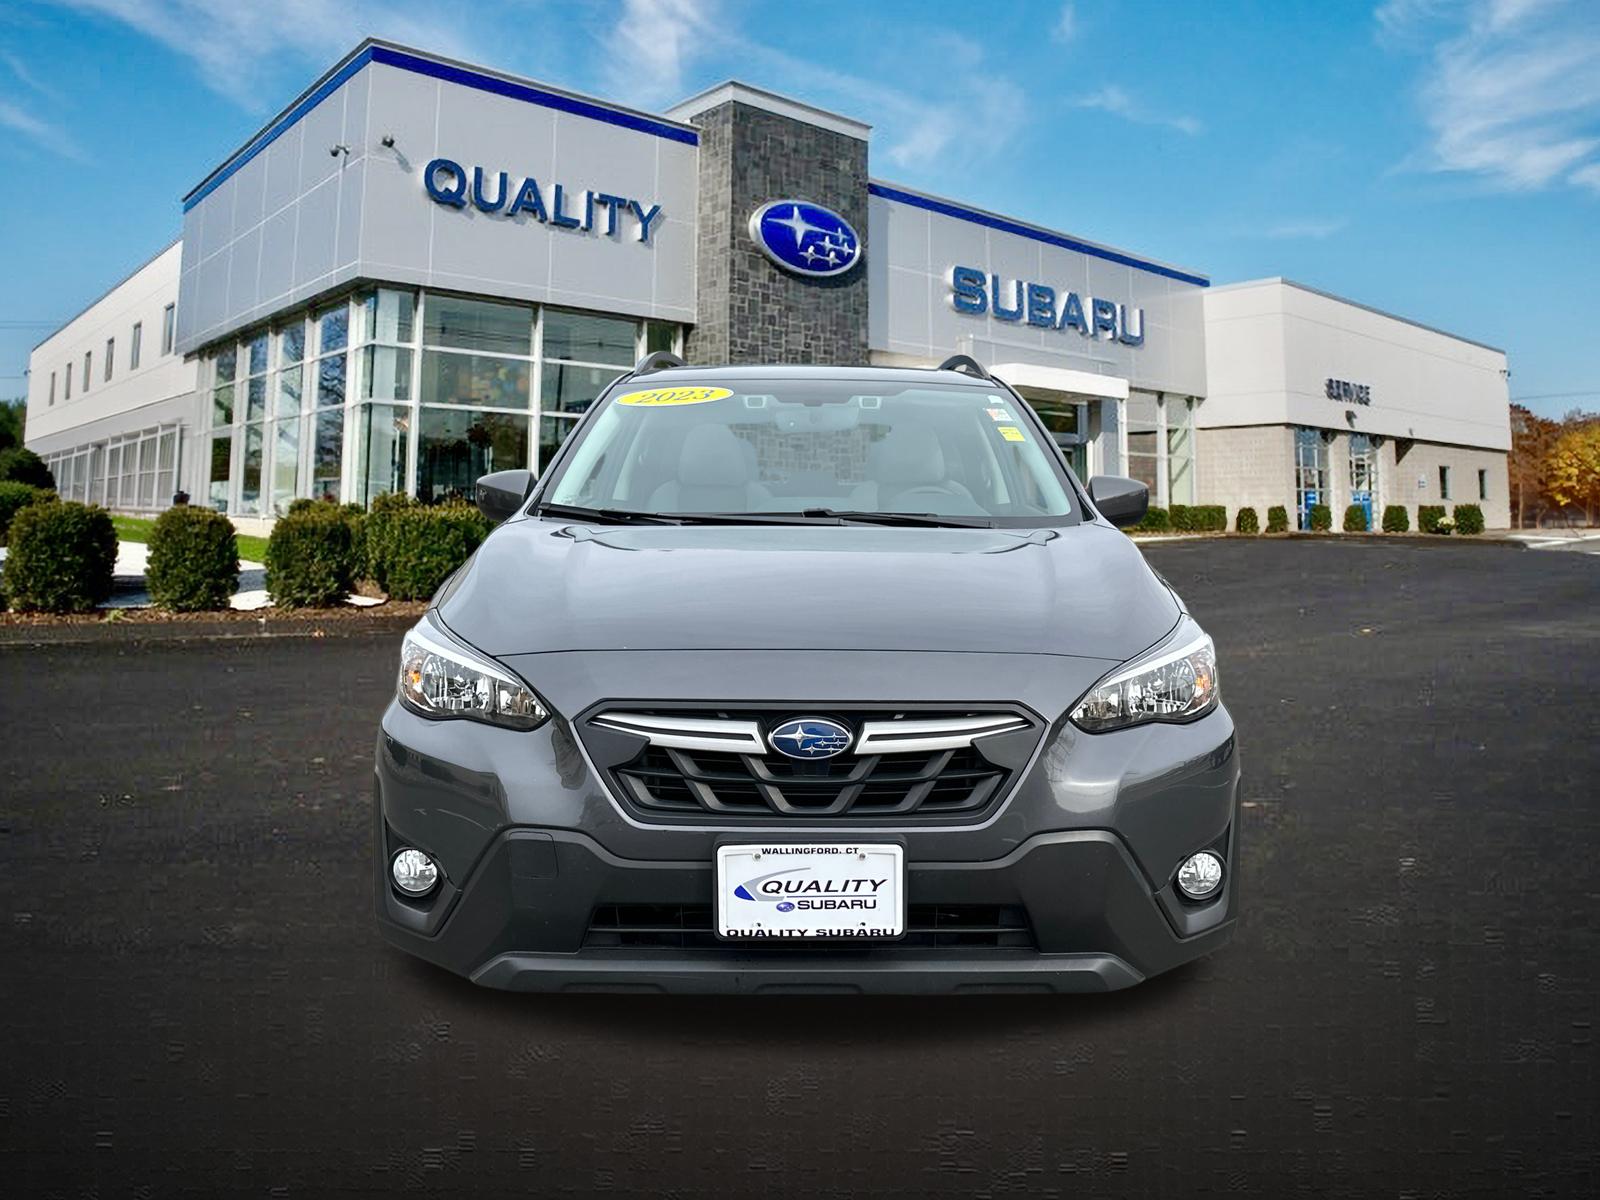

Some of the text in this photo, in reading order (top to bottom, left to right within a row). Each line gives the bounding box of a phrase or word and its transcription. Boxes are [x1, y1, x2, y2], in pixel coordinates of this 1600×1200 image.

[424, 158, 661, 243] QUALITY
[952, 265, 1145, 346] SUBARU
[637, 389, 714, 403] 2023
[1325, 378, 1371, 406] SERVICE
[845, 847, 859, 855] CT
[762, 879, 888, 894] QUALITY
[797, 900, 877, 910] SUBARU
[726, 928, 895, 937] QUALITY SUBARU
